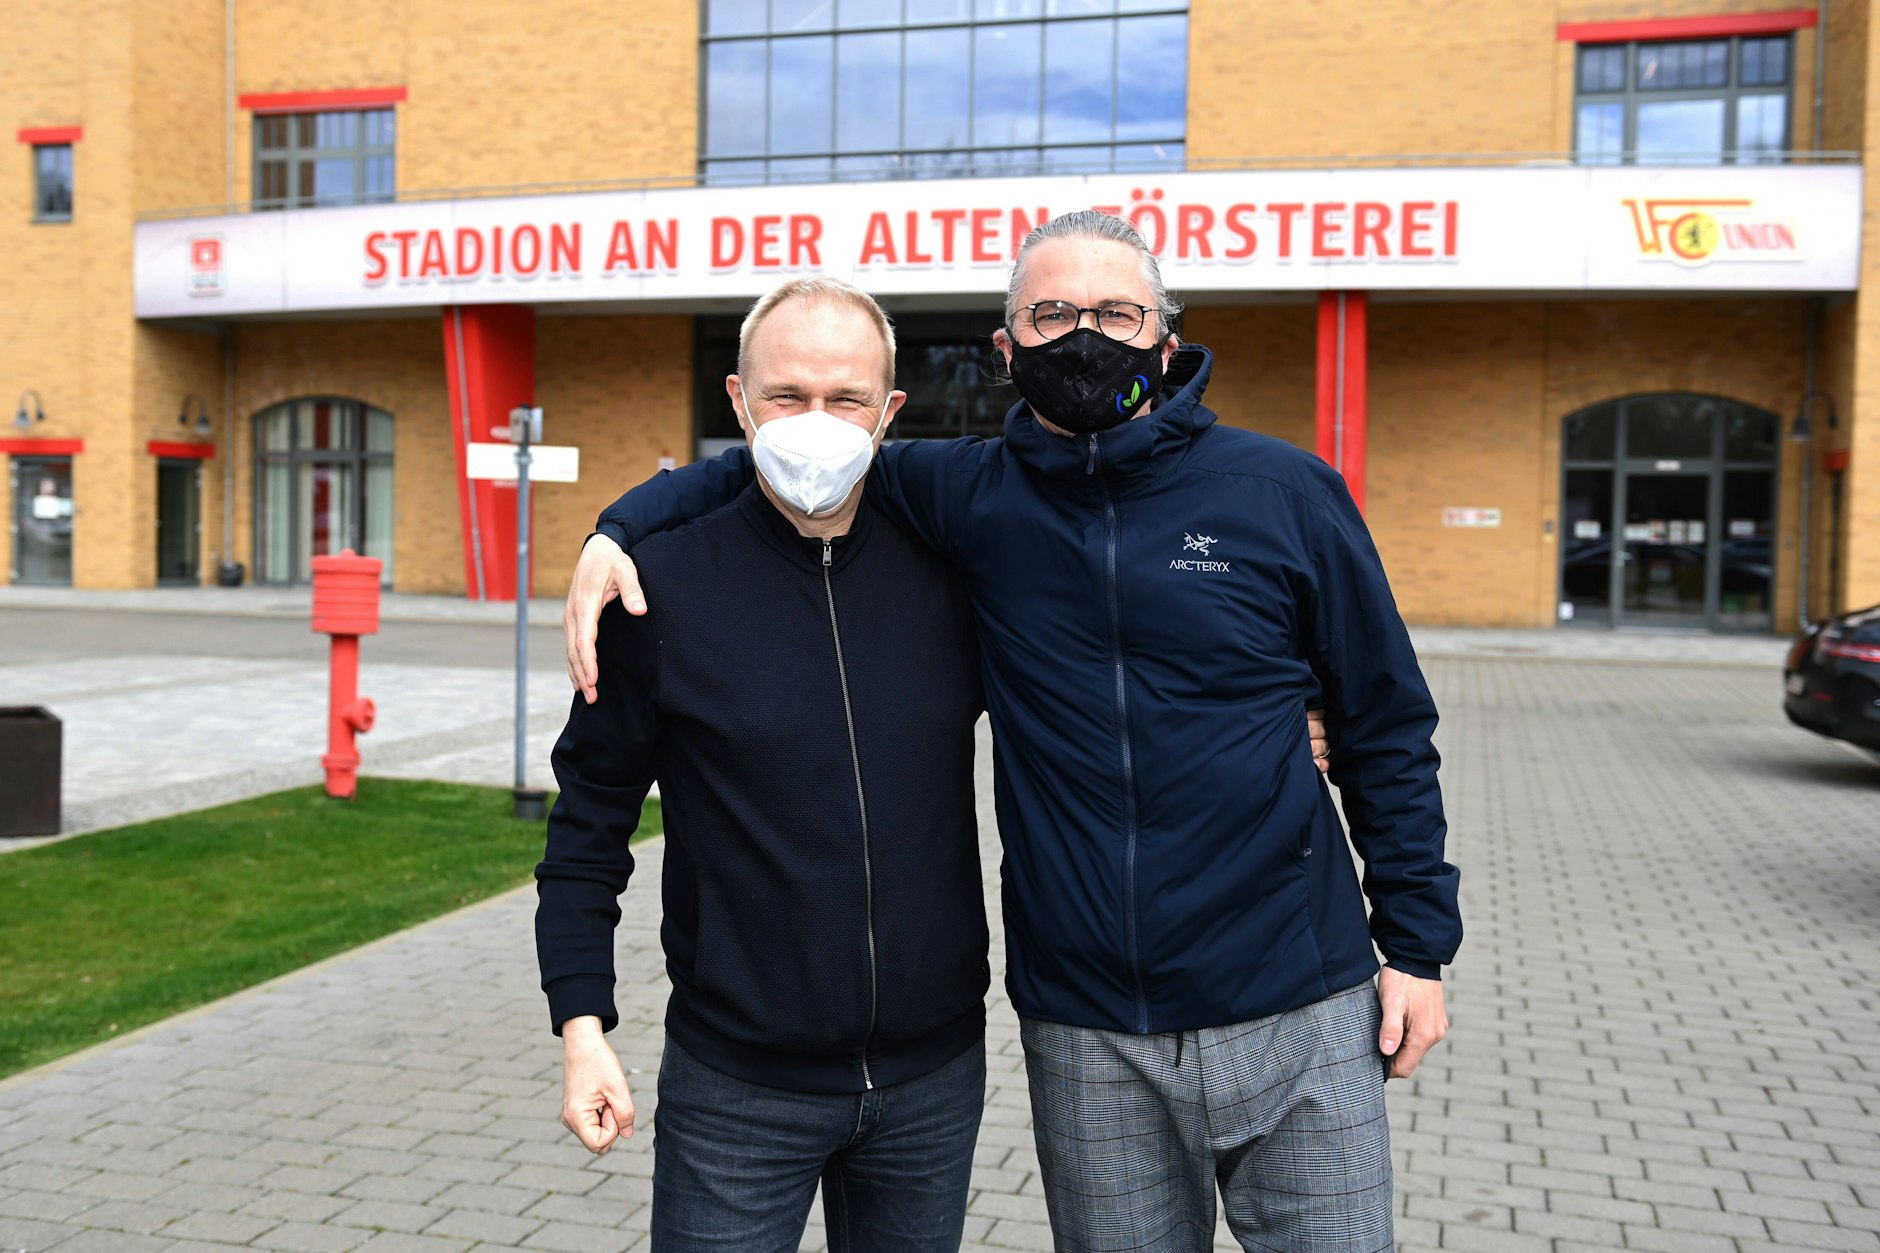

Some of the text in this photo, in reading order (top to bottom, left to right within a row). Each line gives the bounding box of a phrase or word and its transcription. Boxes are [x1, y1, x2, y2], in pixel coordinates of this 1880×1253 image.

[365, 223, 581, 281] STADION
[605, 219, 678, 271] AN
[711, 214, 822, 268] DER
[1091, 187, 1458, 258] ÖRSTEREI
